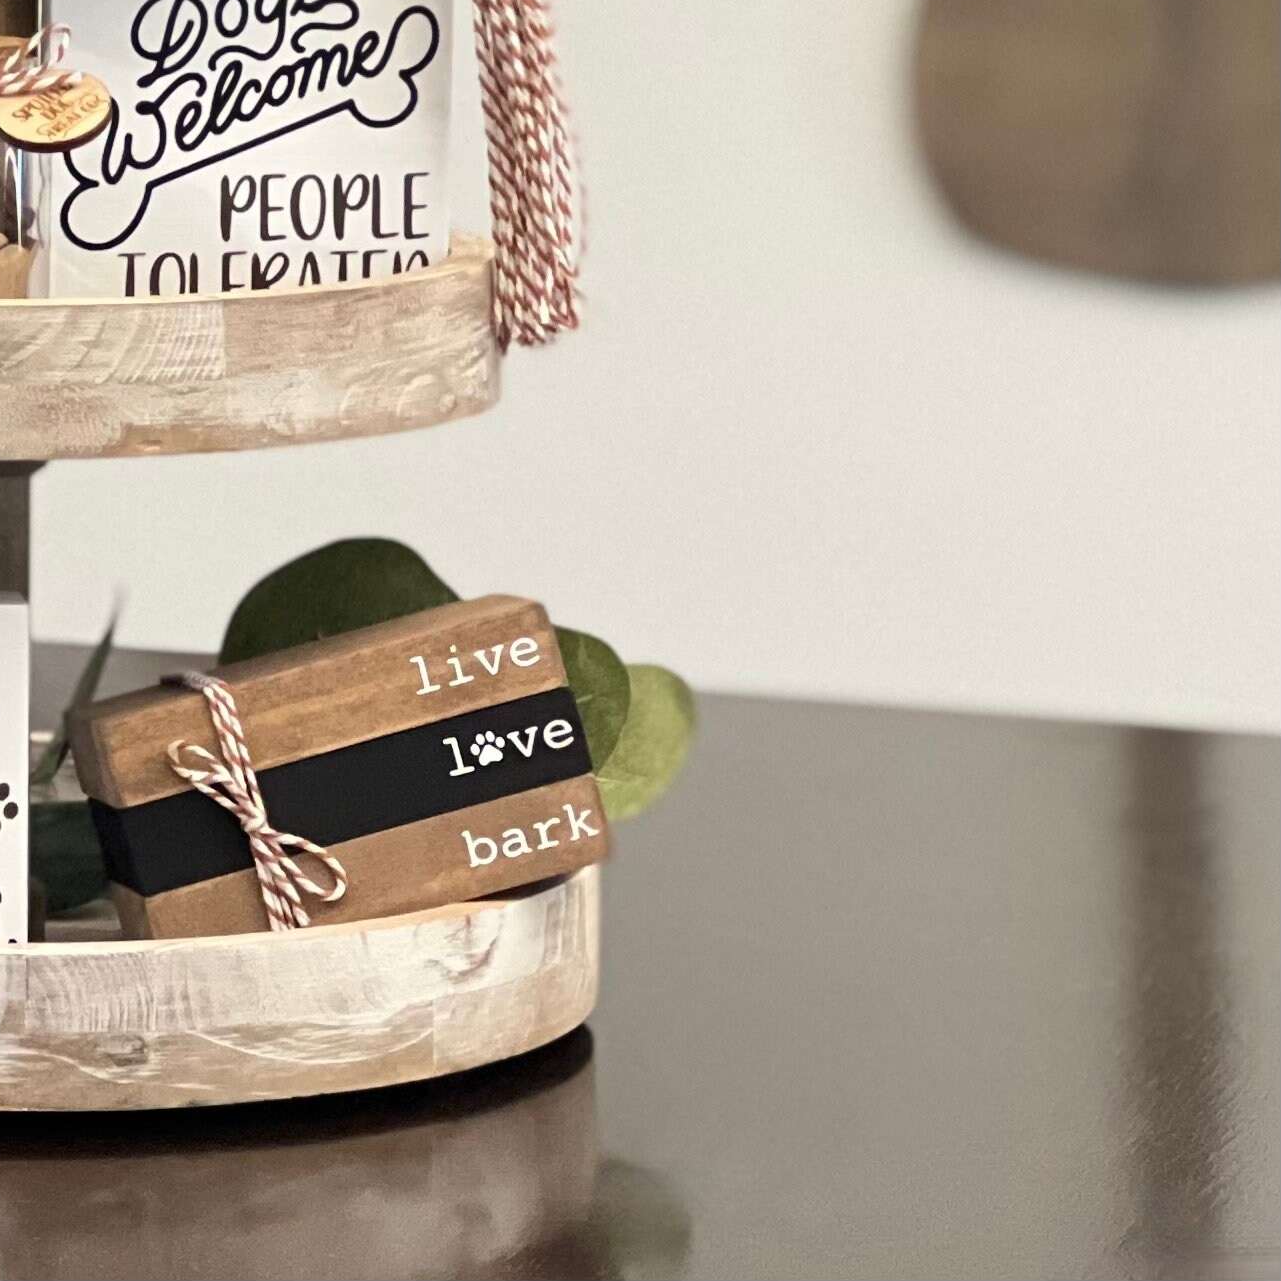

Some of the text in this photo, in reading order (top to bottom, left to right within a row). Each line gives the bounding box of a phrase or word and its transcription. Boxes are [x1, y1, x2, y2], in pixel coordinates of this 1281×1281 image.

[100, 29, 384, 186] Welcome
[220, 172, 431, 243] PEOPLE
[409, 636, 541, 696] live
[461, 804, 600, 868] bark
